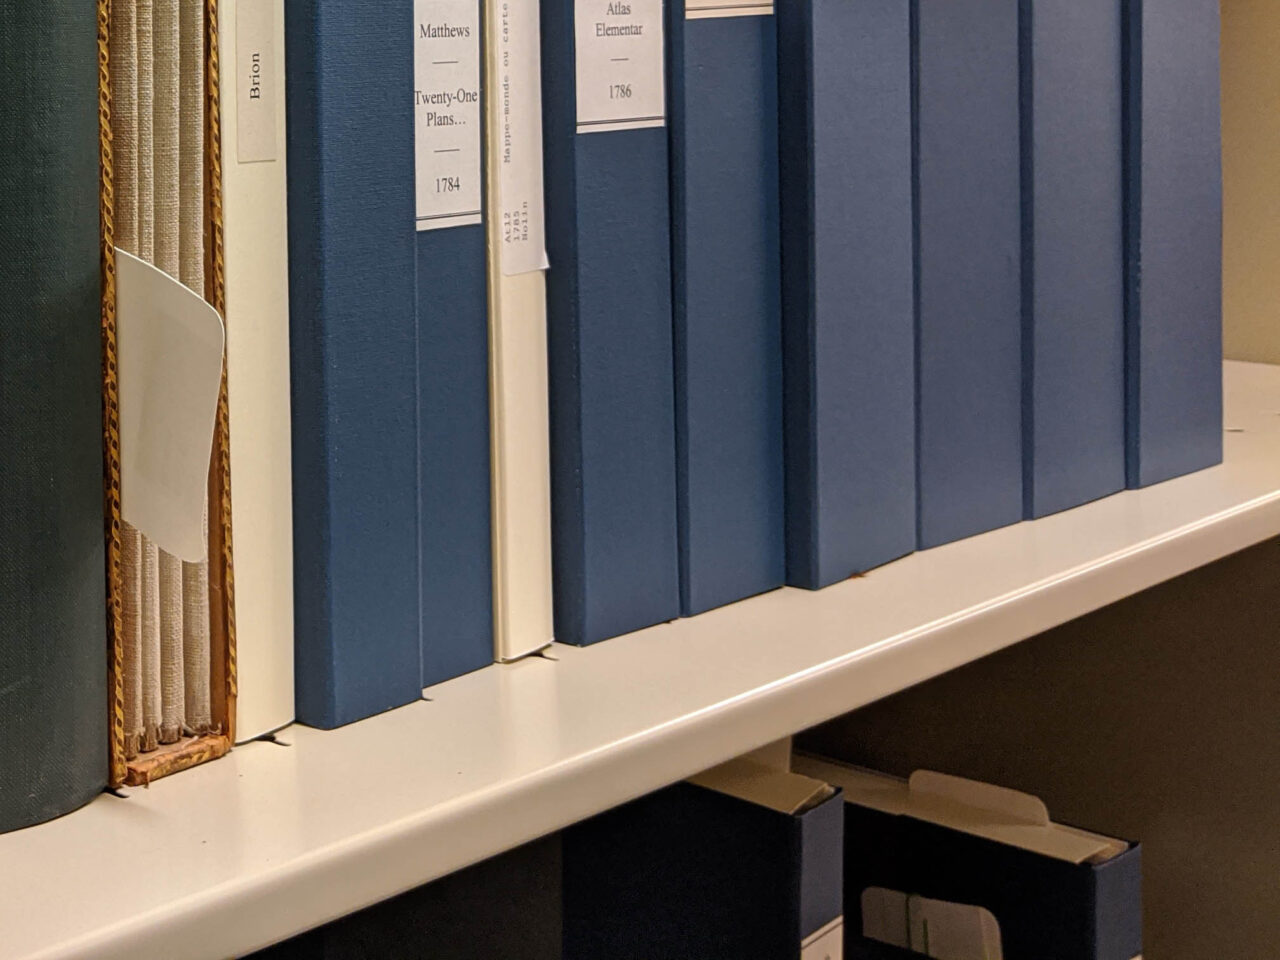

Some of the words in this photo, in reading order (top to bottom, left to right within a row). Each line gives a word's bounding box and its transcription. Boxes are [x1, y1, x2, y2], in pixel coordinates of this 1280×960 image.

[606, 1, 631, 15] Atlas
[420, 23, 470, 39] Matthews
[596, 23, 643, 37] Elementar
[249, 52, 261, 100] Brion
[415, 88, 478, 107] Twenty-One
[609, 84, 632, 99] 1786
[436, 177, 460, 193] 1784
